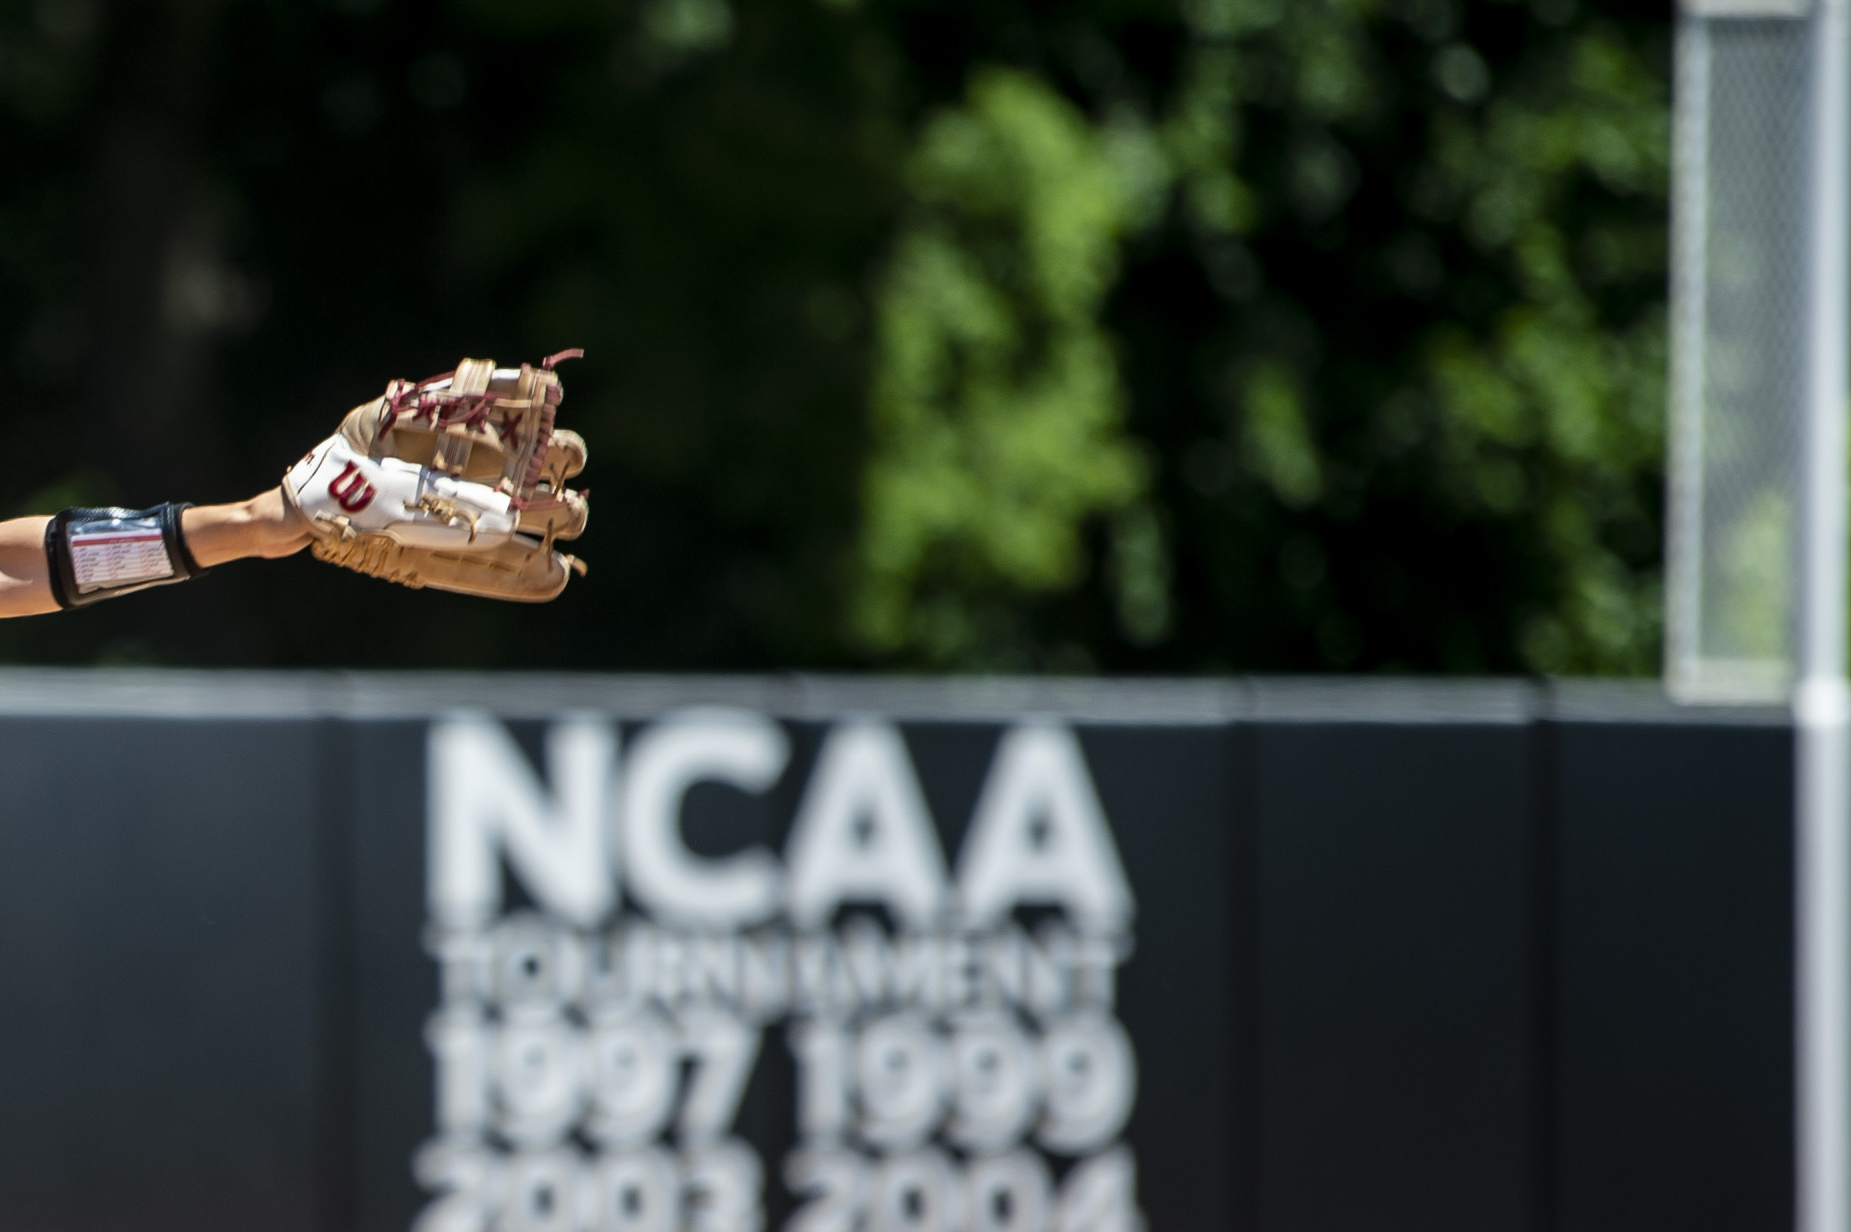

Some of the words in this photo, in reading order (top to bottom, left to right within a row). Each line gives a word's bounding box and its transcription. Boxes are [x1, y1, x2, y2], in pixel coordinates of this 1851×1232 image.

[428, 707, 1136, 930] NCAA
[424, 1010, 762, 1148] 1997
[788, 1010, 1137, 1155] 1999
